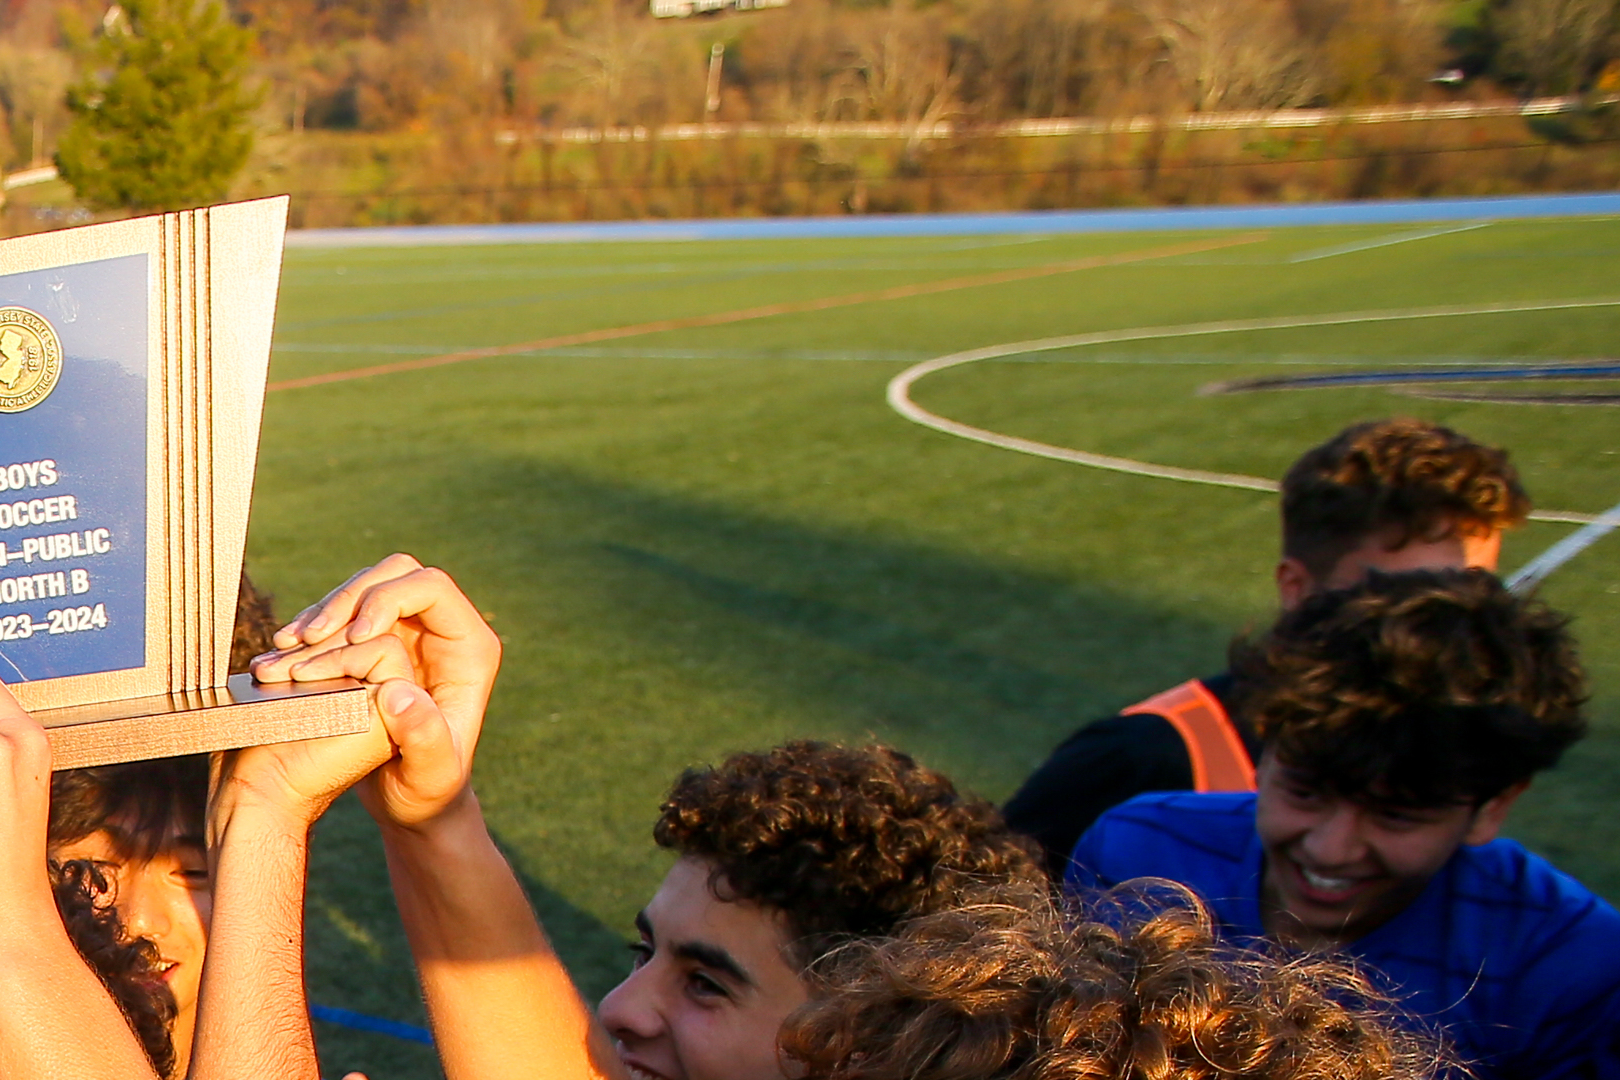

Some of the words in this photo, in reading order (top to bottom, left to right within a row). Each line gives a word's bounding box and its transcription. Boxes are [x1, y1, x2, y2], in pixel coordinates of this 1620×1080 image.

[23, 315, 49, 339] STATE
[27, 346, 39, 372] 1918
[16, 374, 52, 406] ATHLETIC
[70, 568, 90, 595] B
